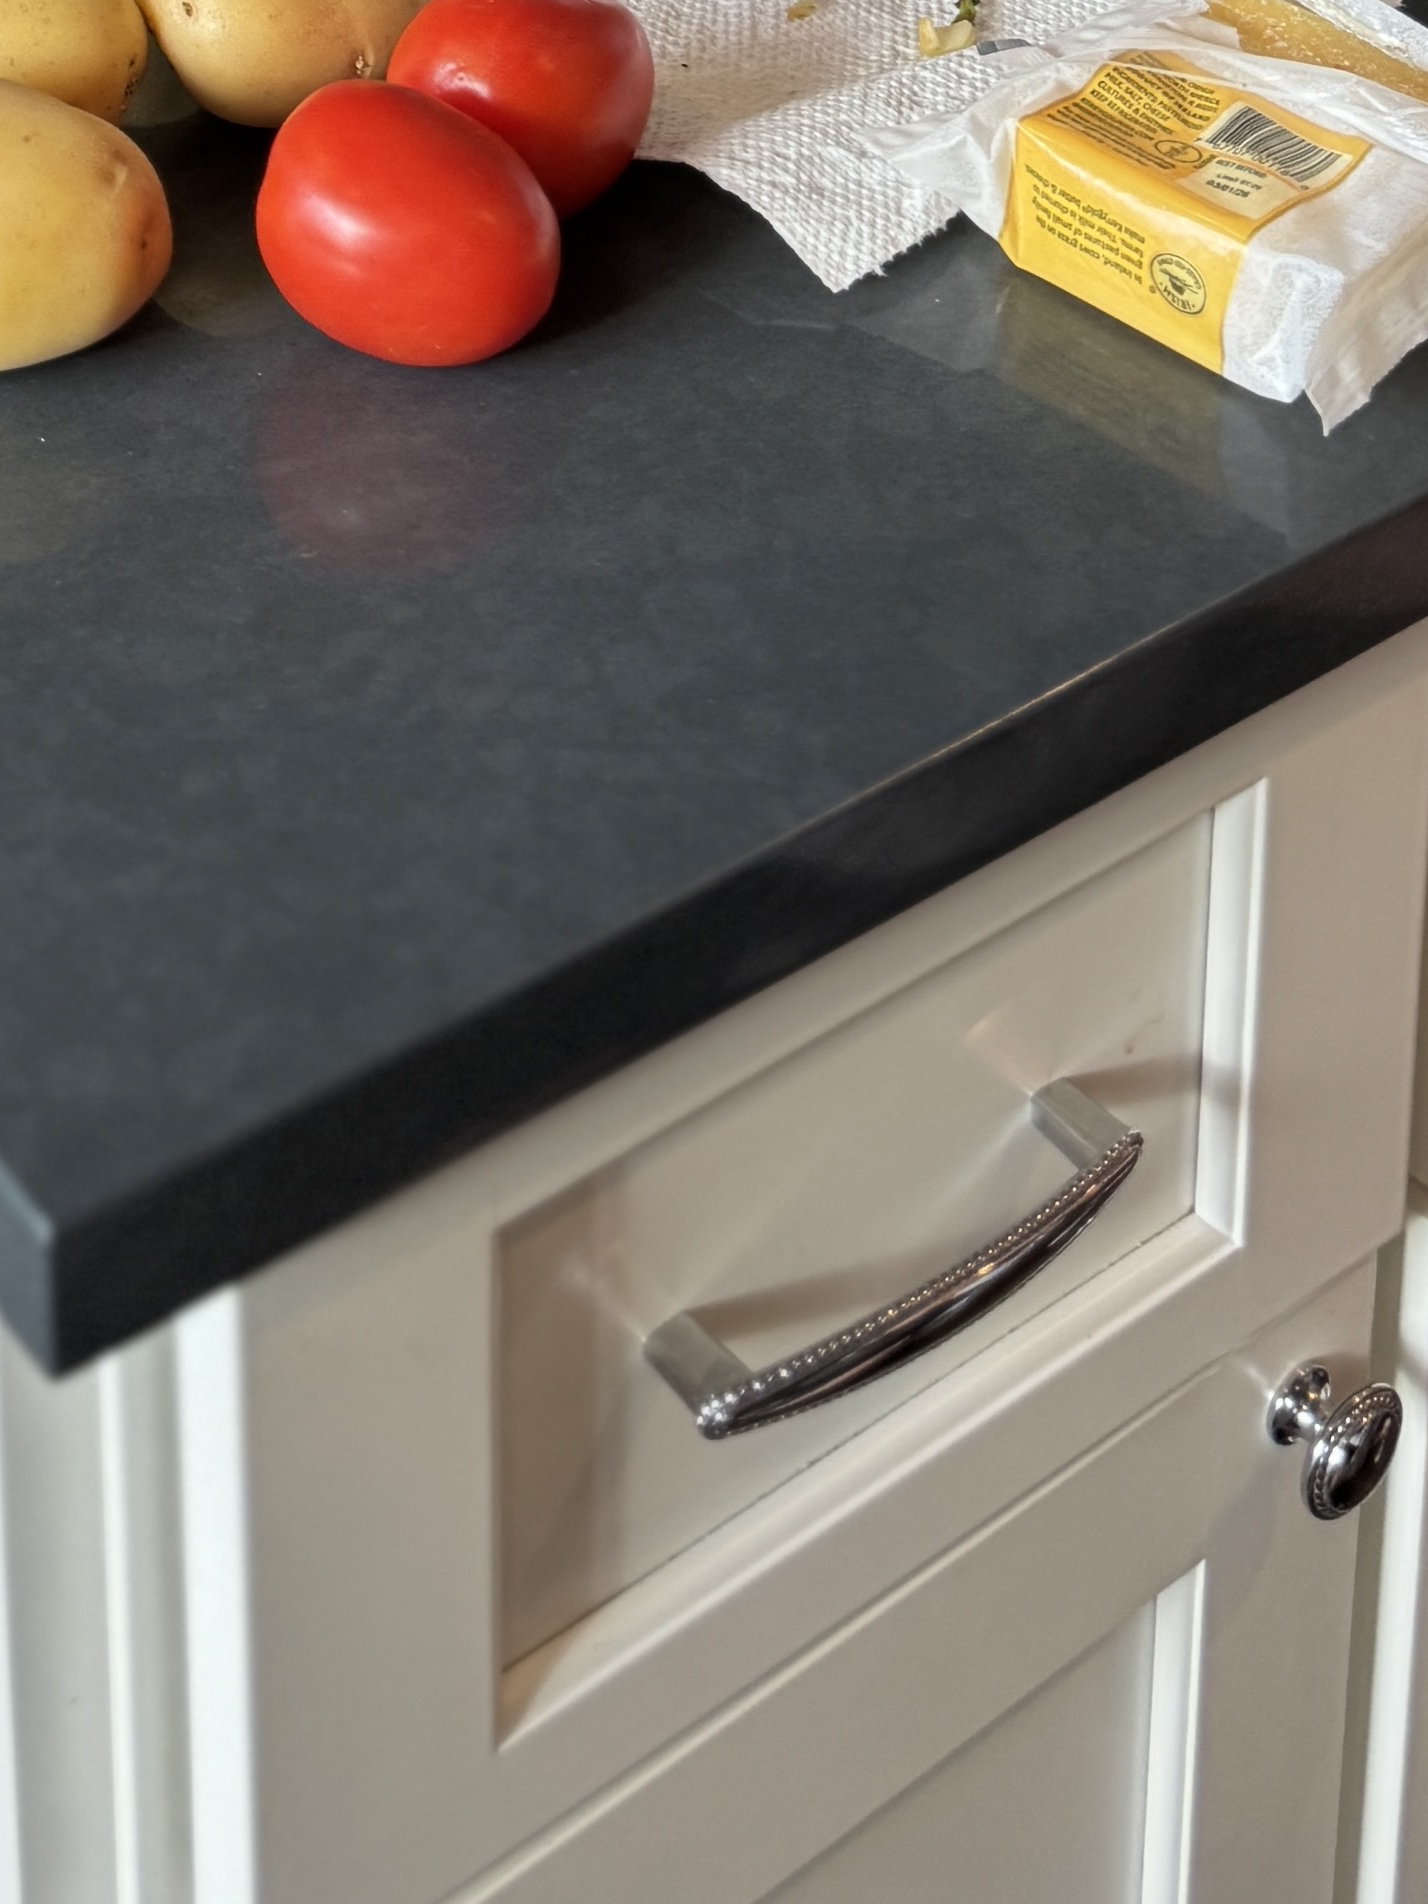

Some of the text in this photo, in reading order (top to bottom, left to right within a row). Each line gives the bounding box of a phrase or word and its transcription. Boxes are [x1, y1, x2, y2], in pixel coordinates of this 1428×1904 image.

[1058, 188, 1081, 208] butter
[1051, 213, 1072, 231] small
[1077, 214, 1095, 230] milk
[1095, 225, 1117, 243] Their
[1079, 243, 1100, 260] cows
[1082, 232, 1119, 257] pastures
[1119, 251, 1142, 269] green
